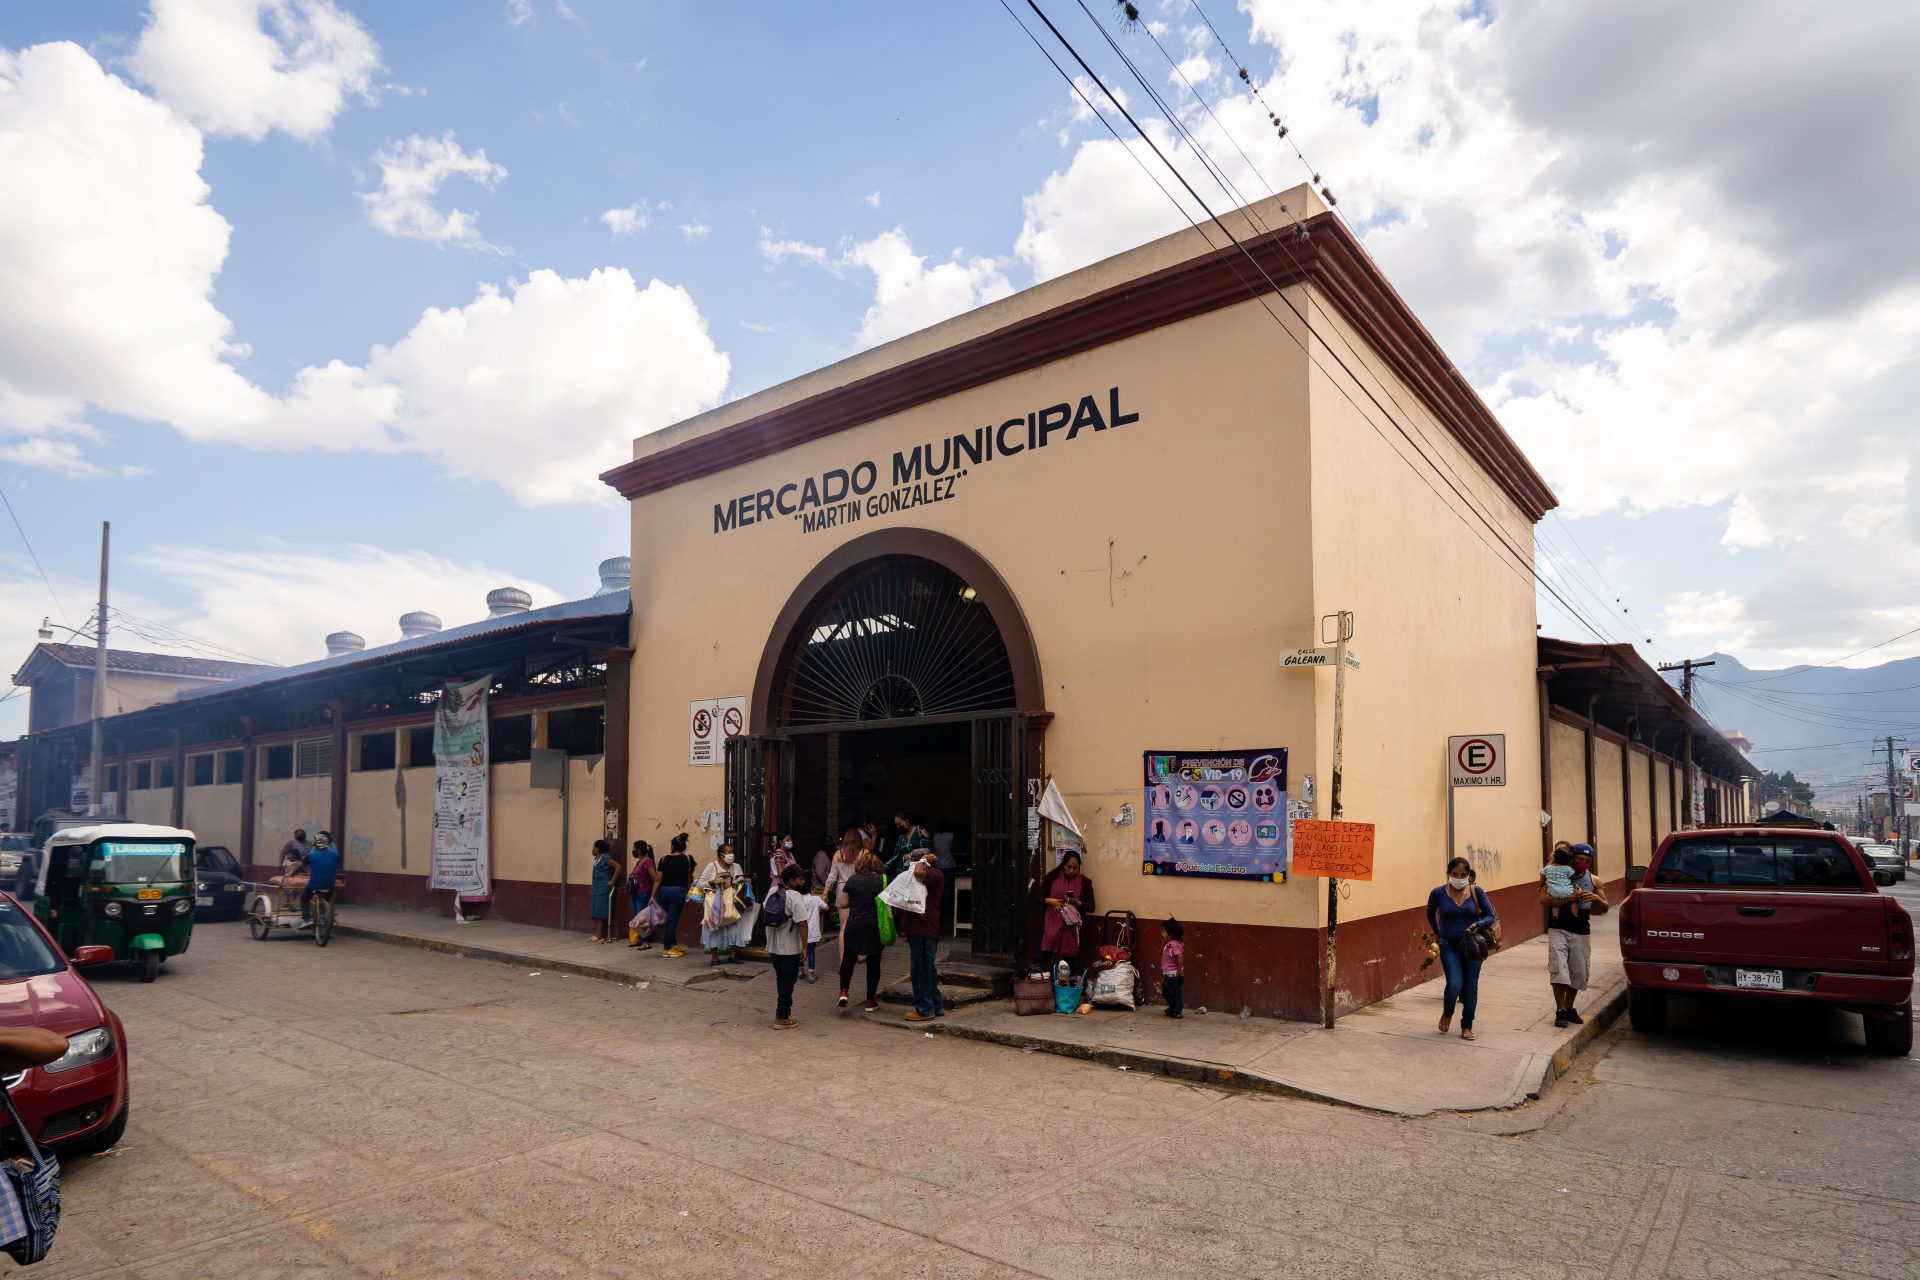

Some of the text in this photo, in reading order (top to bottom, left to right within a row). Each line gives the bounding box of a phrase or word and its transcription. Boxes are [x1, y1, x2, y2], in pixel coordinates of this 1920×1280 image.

[713, 386, 1140, 533] MERCADO MUNICIPAL
[1284, 655, 1326, 666] GALEANA
[1181, 757, 1245, 767] PREVENCIÓN DE
[1467, 745, 1487, 768] E
[1453, 777, 1483, 785] MAXIMO
[1295, 820, 1374, 833] ROSTICERIA
[1296, 831, 1372, 843] JUQUILITA
[139, 889, 162, 899] 59
[1647, 930, 1705, 940] DODGE
